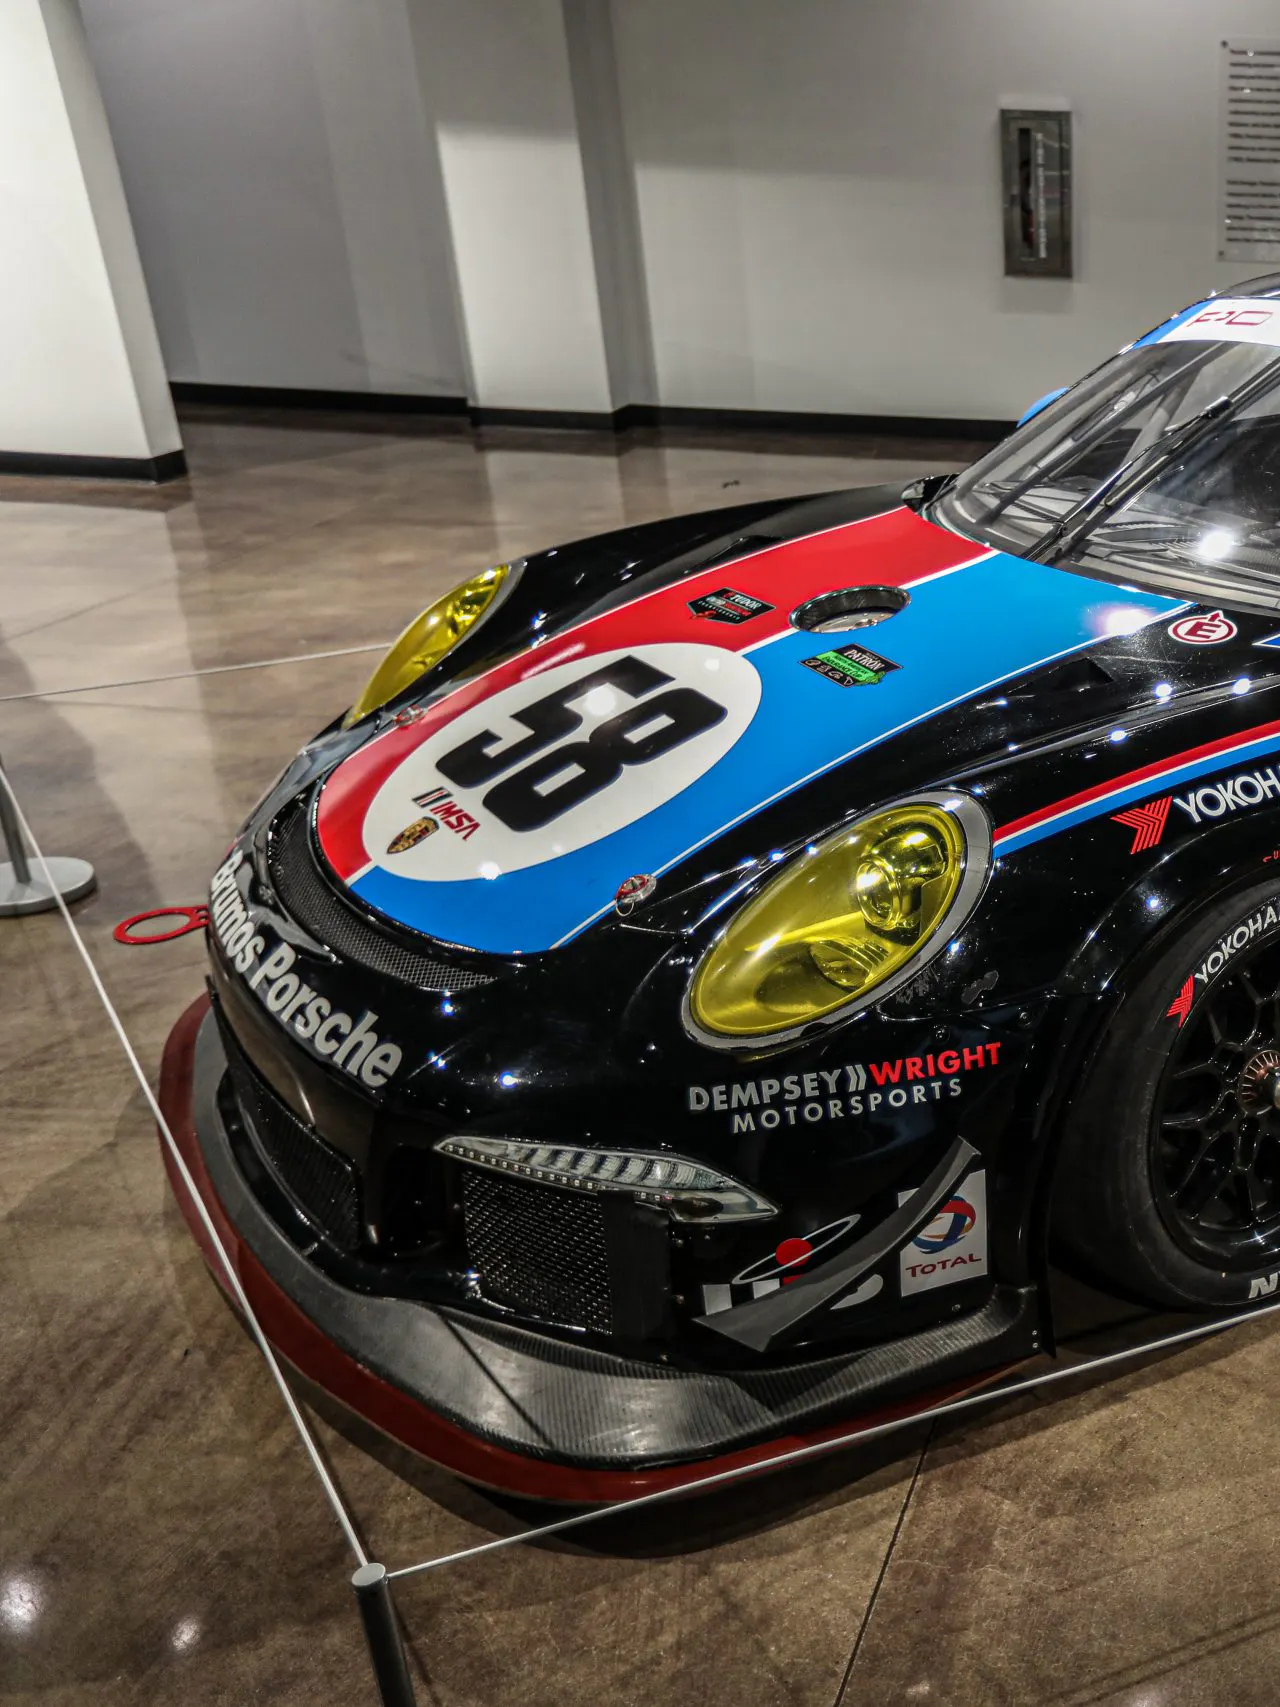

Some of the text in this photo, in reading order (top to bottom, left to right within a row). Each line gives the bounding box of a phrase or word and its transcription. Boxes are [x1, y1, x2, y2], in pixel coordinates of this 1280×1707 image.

[1184, 621, 1222, 639] E
[435, 655, 728, 833] 58
[429, 800, 481, 841] IMSA
[211, 848, 265, 973] Brumos
[250, 942, 402, 1087] Porsche
[689, 1042, 1001, 1112] DEMPSEY WRIGHT
[733, 1079, 962, 1134] MOTORSPORTS
[905, 1253, 983, 1278] TOTAL
